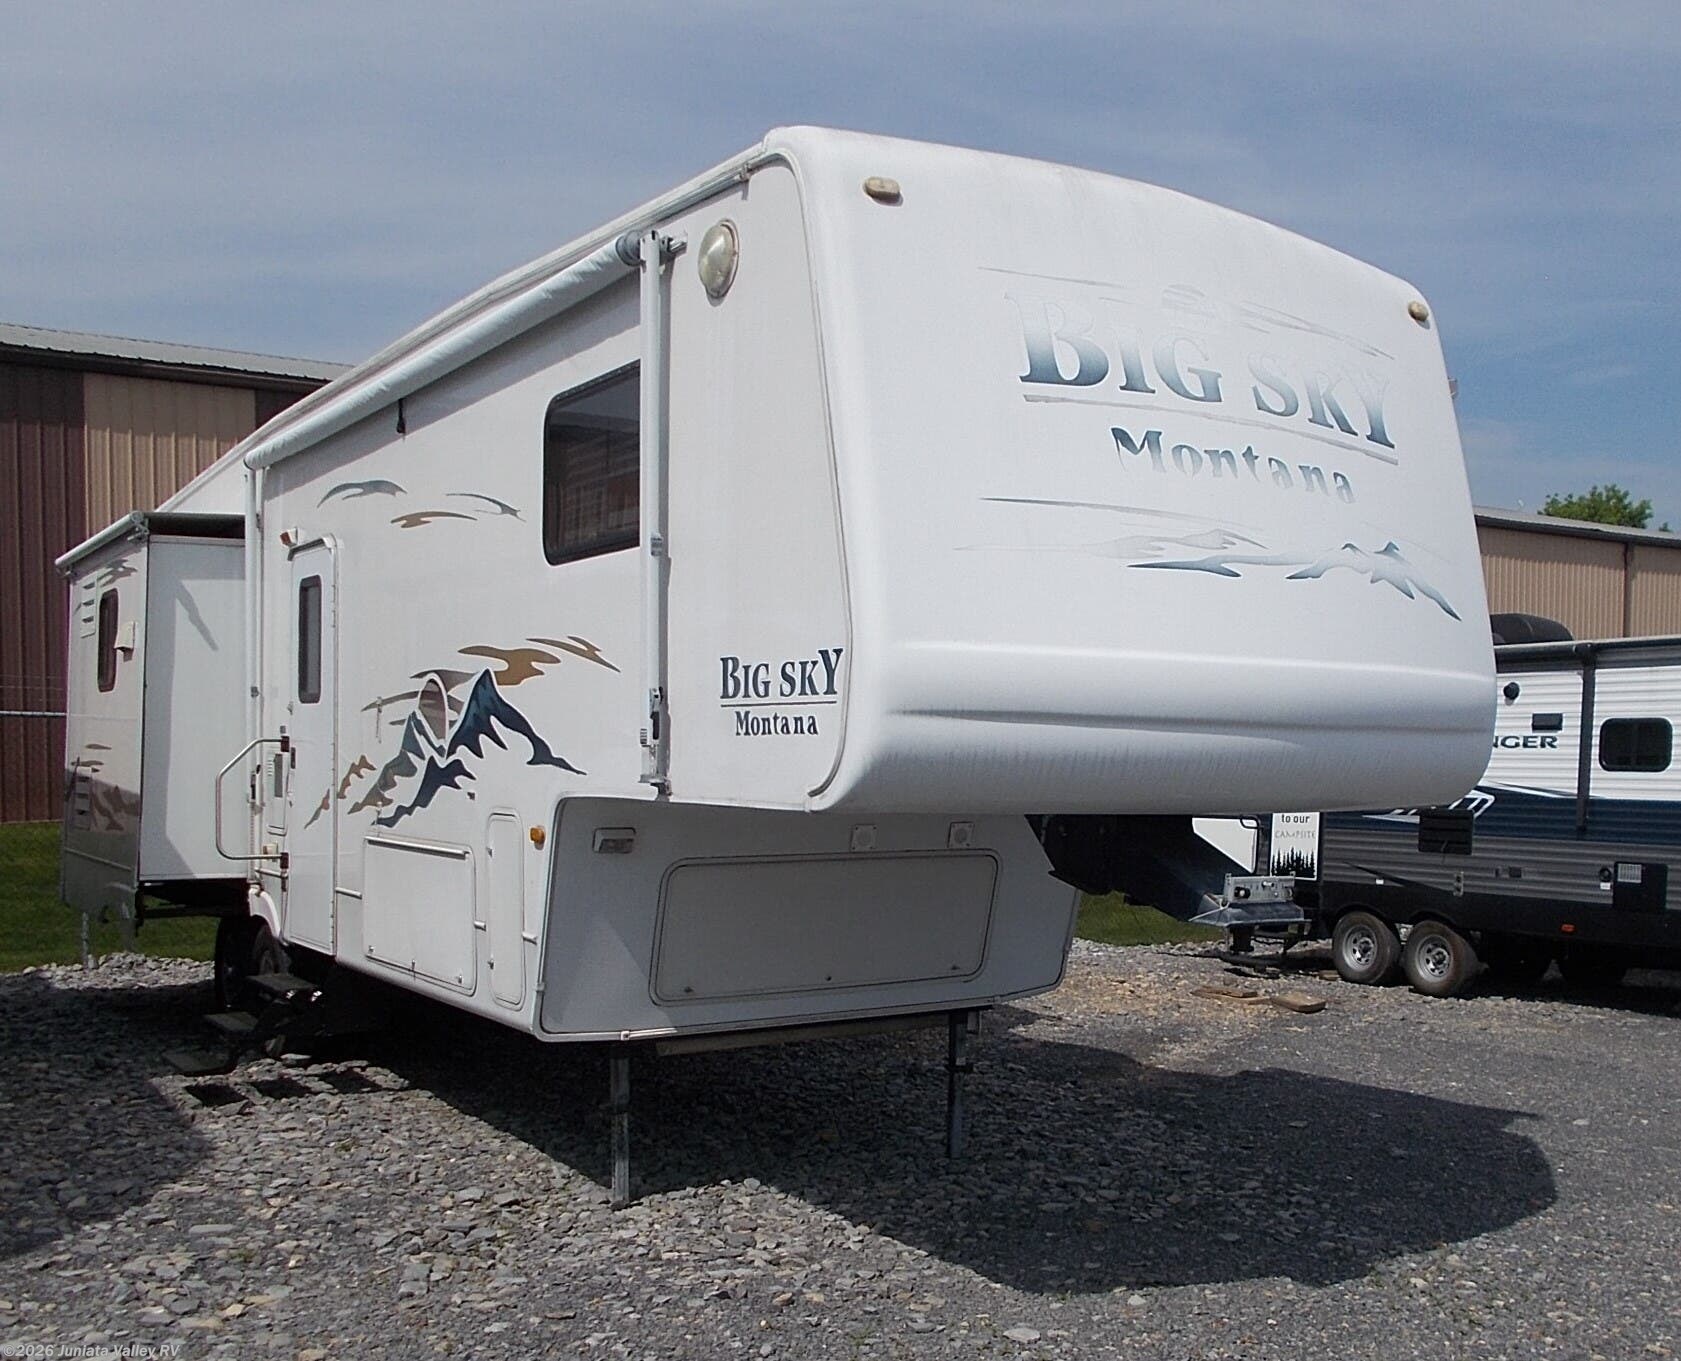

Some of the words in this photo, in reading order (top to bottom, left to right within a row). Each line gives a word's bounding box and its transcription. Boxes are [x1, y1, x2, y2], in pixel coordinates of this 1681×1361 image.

[1004, 293, 1223, 403] BIG
[1247, 352, 1396, 449] SKY
[1110, 427, 1356, 504] Montana
[719, 656, 771, 699] BIG
[735, 710, 819, 736] Montana
[1281, 814, 1291, 823] to
[1293, 815, 1310, 823] our
